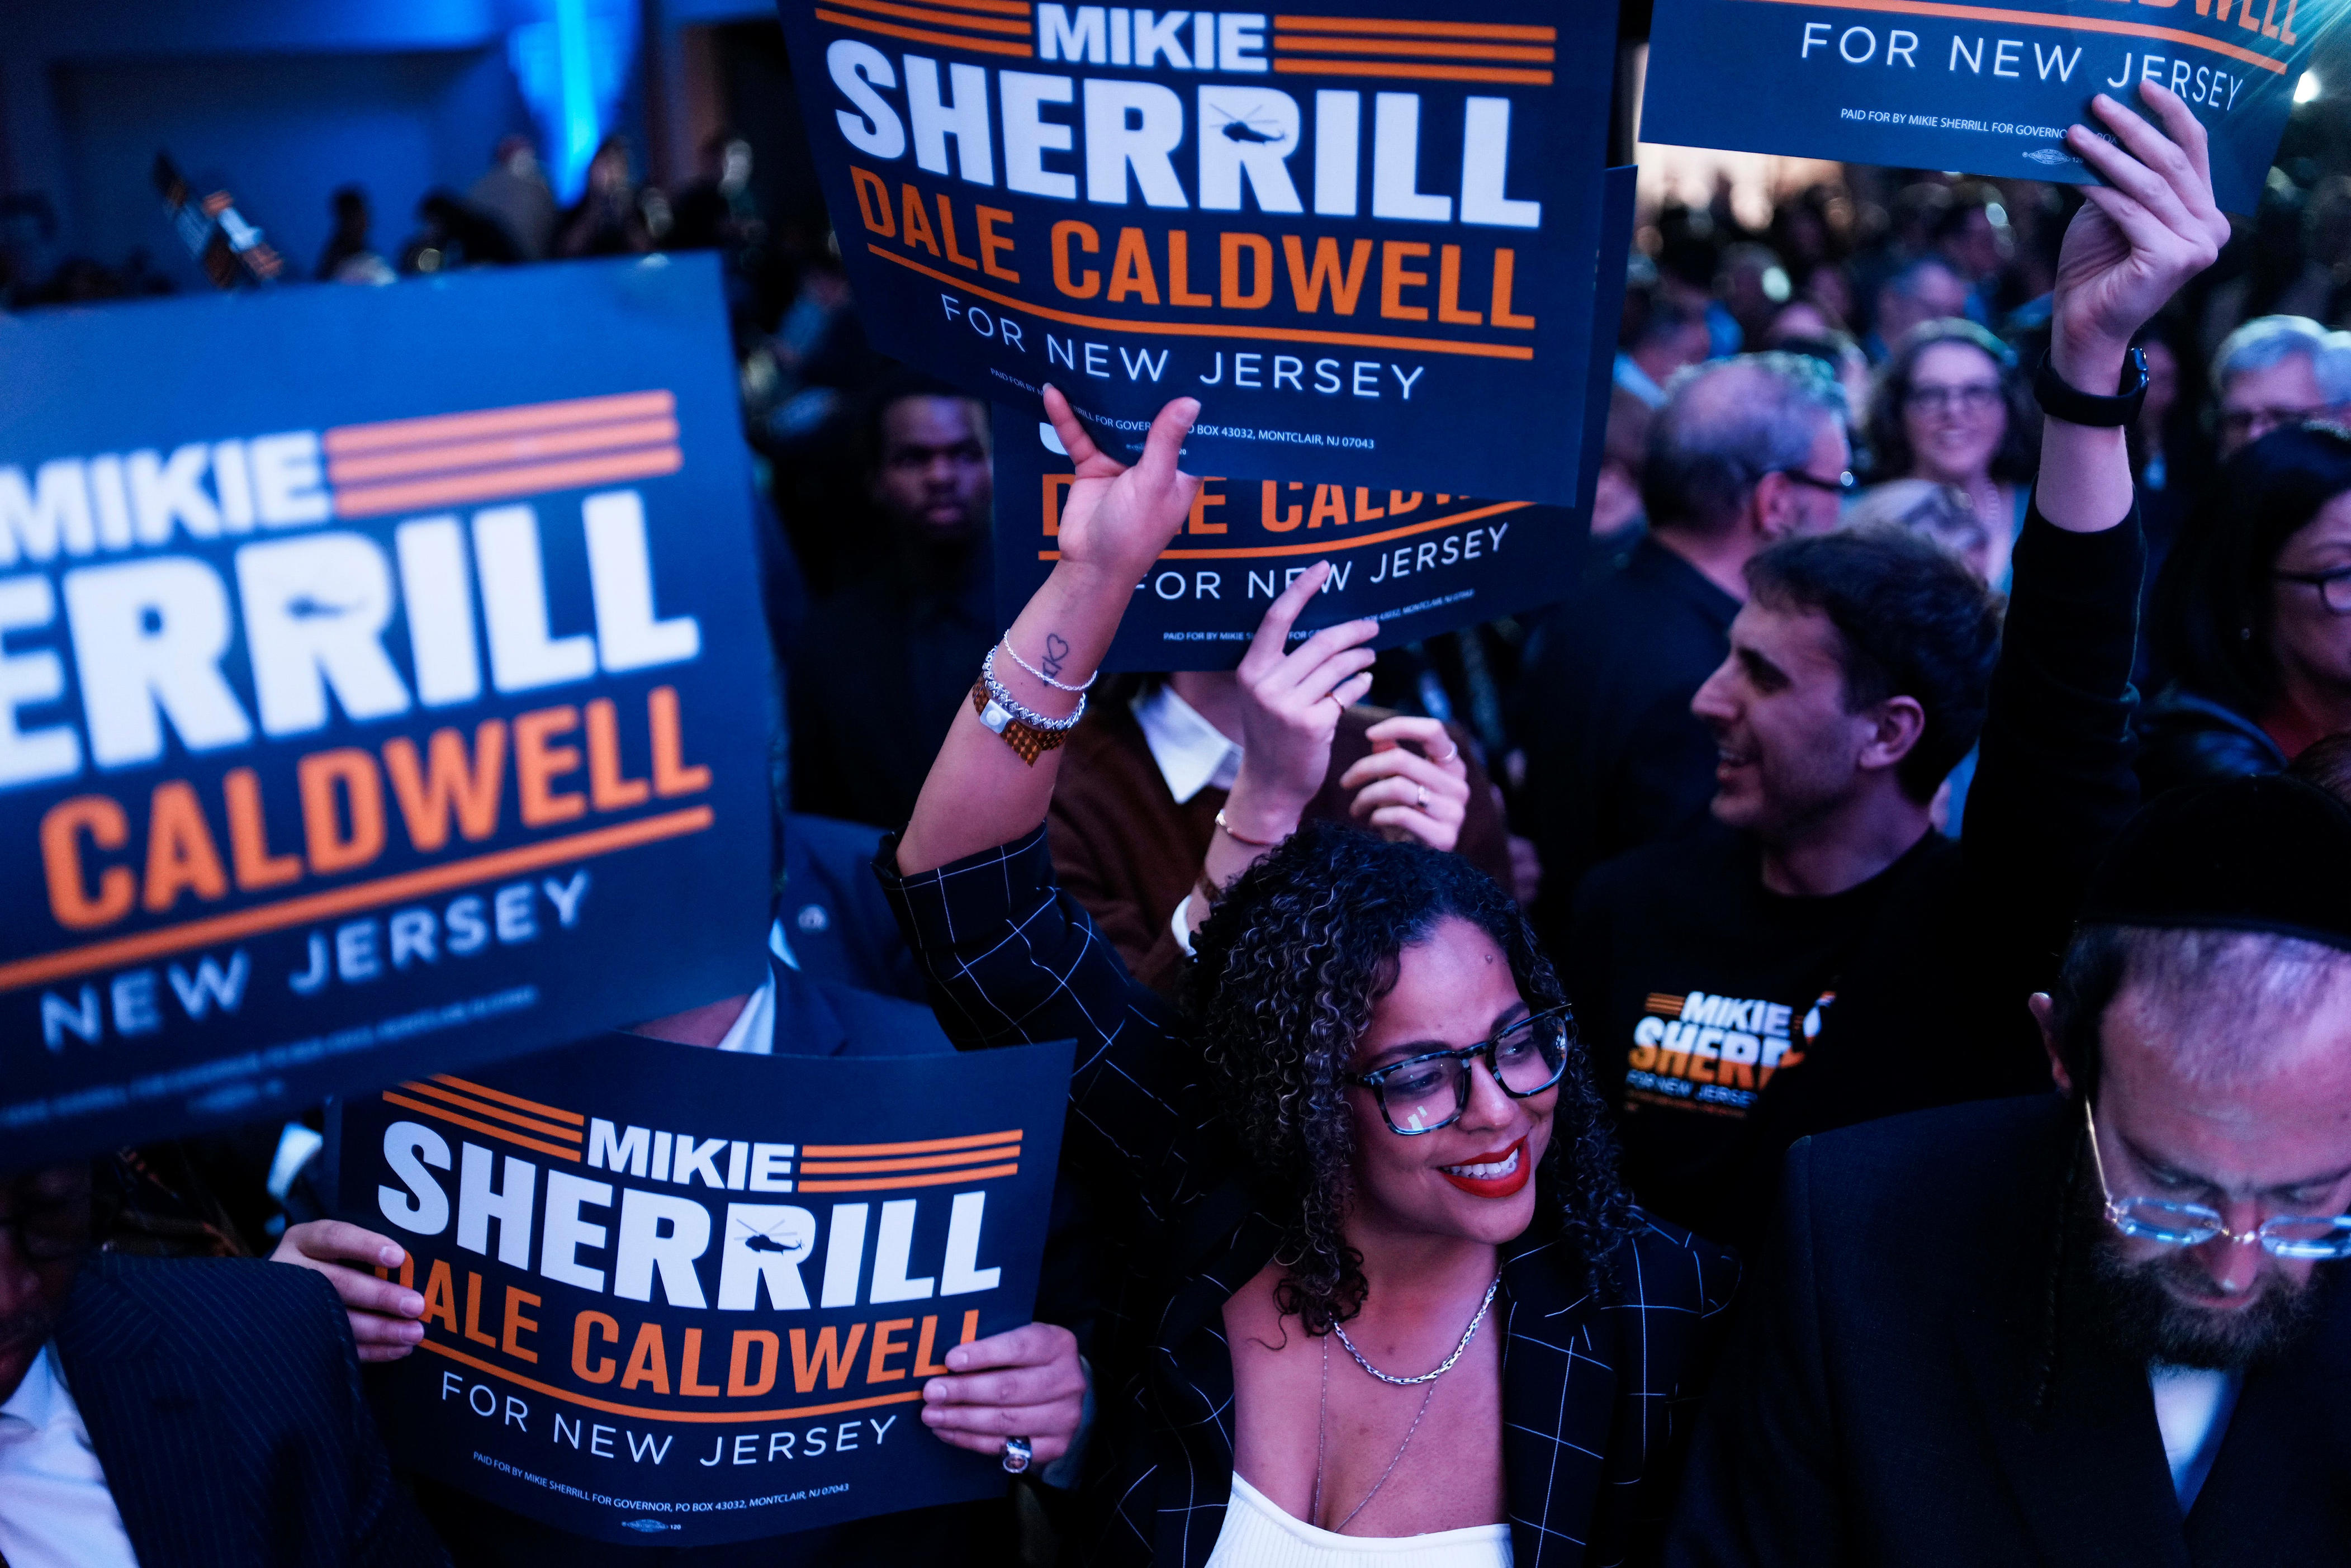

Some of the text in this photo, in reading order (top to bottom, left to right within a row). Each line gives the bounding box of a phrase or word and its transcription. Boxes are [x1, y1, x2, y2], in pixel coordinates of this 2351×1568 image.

[1037, 3, 1268, 72] MIKIE
[1802, 22, 2243, 111] FOR NEW JERSEY
[827, 39, 1541, 228] SHERRILL
[1841, 108, 2067, 139] PAID FOR BY MIKIE SHERRILL FOR GOVERNO
[850, 165, 1535, 330] DALE CALDWELL
[941, 293, 1424, 400] FOR NEW JERSEY
[990, 367, 1008, 381] PAID
[1009, 376, 1025, 389] FOR
[1026, 382, 1035, 393] BY
[1096, 414, 1113, 428] FOR
[1197, 424, 1219, 436] BOX
[1221, 427, 1255, 440] 43032,
[1258, 429, 1324, 446] MONTCLAIR,
[1326, 435, 1340, 446] NJ
[1342, 437, 1374, 449] 07043
[0, 429, 335, 566] MIKIE
[1136, 571, 1221, 600] OR
[1370, 522, 1508, 584] JERSEY
[40, 686, 712, 929] CALDWELL
[40, 948, 252, 1051] NEW
[287, 870, 590, 994] JERSEY
[1680, 991, 1793, 1038] MIKIE
[587, 1117, 794, 1192] MIKIE
[378, 1121, 1001, 1310] SHERRILL
[442, 1371, 897, 1467] FOR NEW JERSEY
[473, 1451, 492, 1466] PAID
[494, 1460, 510, 1474] FOR
[512, 1466, 523, 1477] BY
[524, 1471, 548, 1487] MIKIE
[549, 1480, 590, 1501] SHERRILL
[593, 1493, 612, 1506] FOR
[614, 1498, 673, 1513] GOVERNOR,
[675, 1502, 690, 1512] PO
[692, 1502, 713, 1512] BOX
[715, 1499, 747, 1510] 43032,
[808, 1488, 821, 1498] NJ
[822, 1483, 850, 1496] 07043
